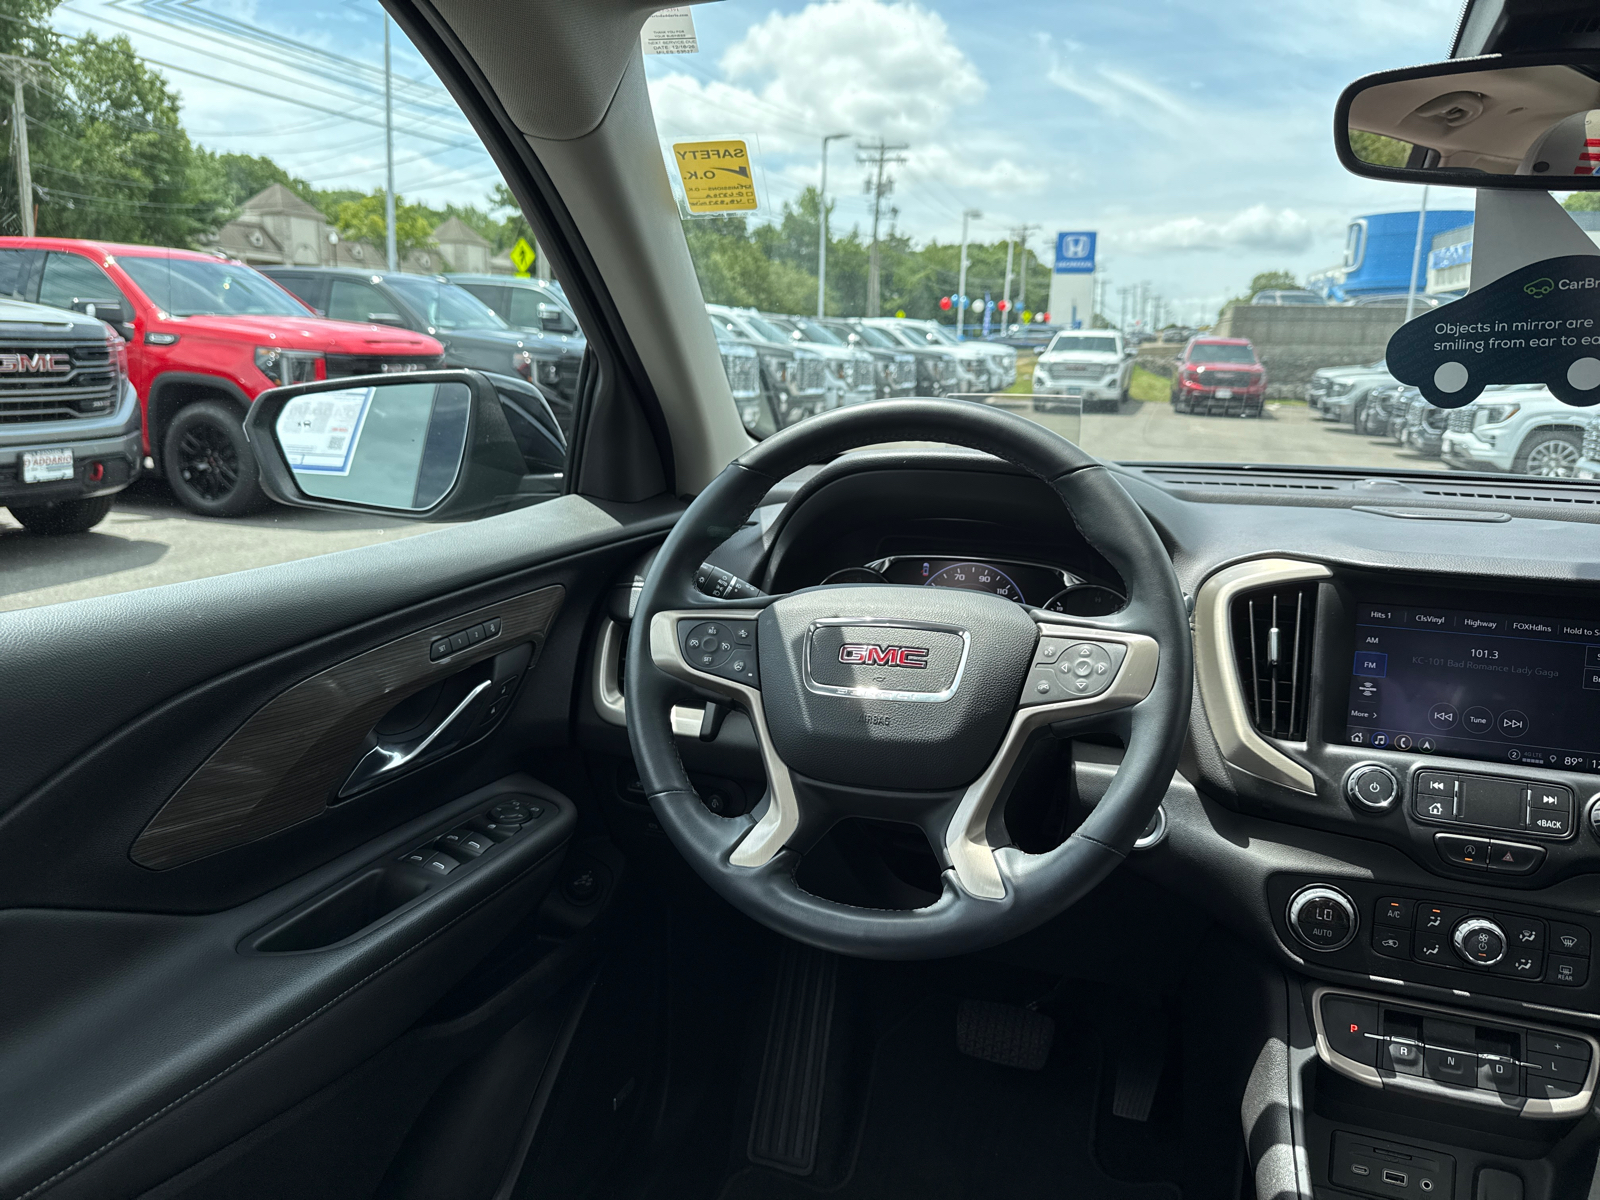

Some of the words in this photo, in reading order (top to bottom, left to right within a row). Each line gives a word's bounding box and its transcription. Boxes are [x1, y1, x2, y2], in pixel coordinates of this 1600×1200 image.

[1558, 277, 1600, 291] CarBr
[1434, 321, 1491, 337] Objects
[1494, 320, 1508, 332] in
[1512, 319, 1562, 332] mirror
[1566, 318, 1594, 329] are
[1433, 338, 1485, 354] smiling
[1488, 337, 1525, 349] from
[1529, 336, 1557, 348] ear
[1561, 335, 1577, 346] to
[0, 353, 71, 373] GMC
[953, 572, 966, 582] 70
[978, 574, 991, 584] 90
[1370, 610, 1386, 619] Hits
[1387, 611, 1391, 619] 1
[1415, 614, 1445, 625] ClsVinyl
[1464, 618, 1497, 629] Highway
[1512, 621, 1552, 633] FOXHdlns
[1563, 626, 1583, 636] Hold
[1584, 628, 1593, 636] to
[1365, 636, 1379, 645] AM
[838, 643, 929, 669] GMC
[1470, 648, 1499, 660] 101.3
[1364, 661, 1377, 670] FM
[1412, 656, 1445, 667] KC-101
[1447, 658, 1465, 668] Bad
[1467, 661, 1509, 673] Romance
[1511, 664, 1533, 676] Lady
[1535, 667, 1559, 678] Gaga
[1351, 709, 1369, 719] More
[859, 714, 891, 726] AIRBAG
[1469, 716, 1487, 725] Tune
[1523, 750, 1532, 758] 4G
[1532, 751, 1543, 759] LTE
[1541, 819, 1562, 830] BACK
[1316, 909, 1333, 921] LO
[1387, 909, 1401, 919] A/C
[1312, 927, 1333, 938] AUTO
[1557, 973, 1573, 982] REAR
[1350, 1024, 1358, 1033] P
[1400, 1046, 1408, 1056] R
[1447, 1056, 1455, 1066] N
[1496, 1064, 1503, 1074] D
[1551, 1062, 1557, 1071] L
